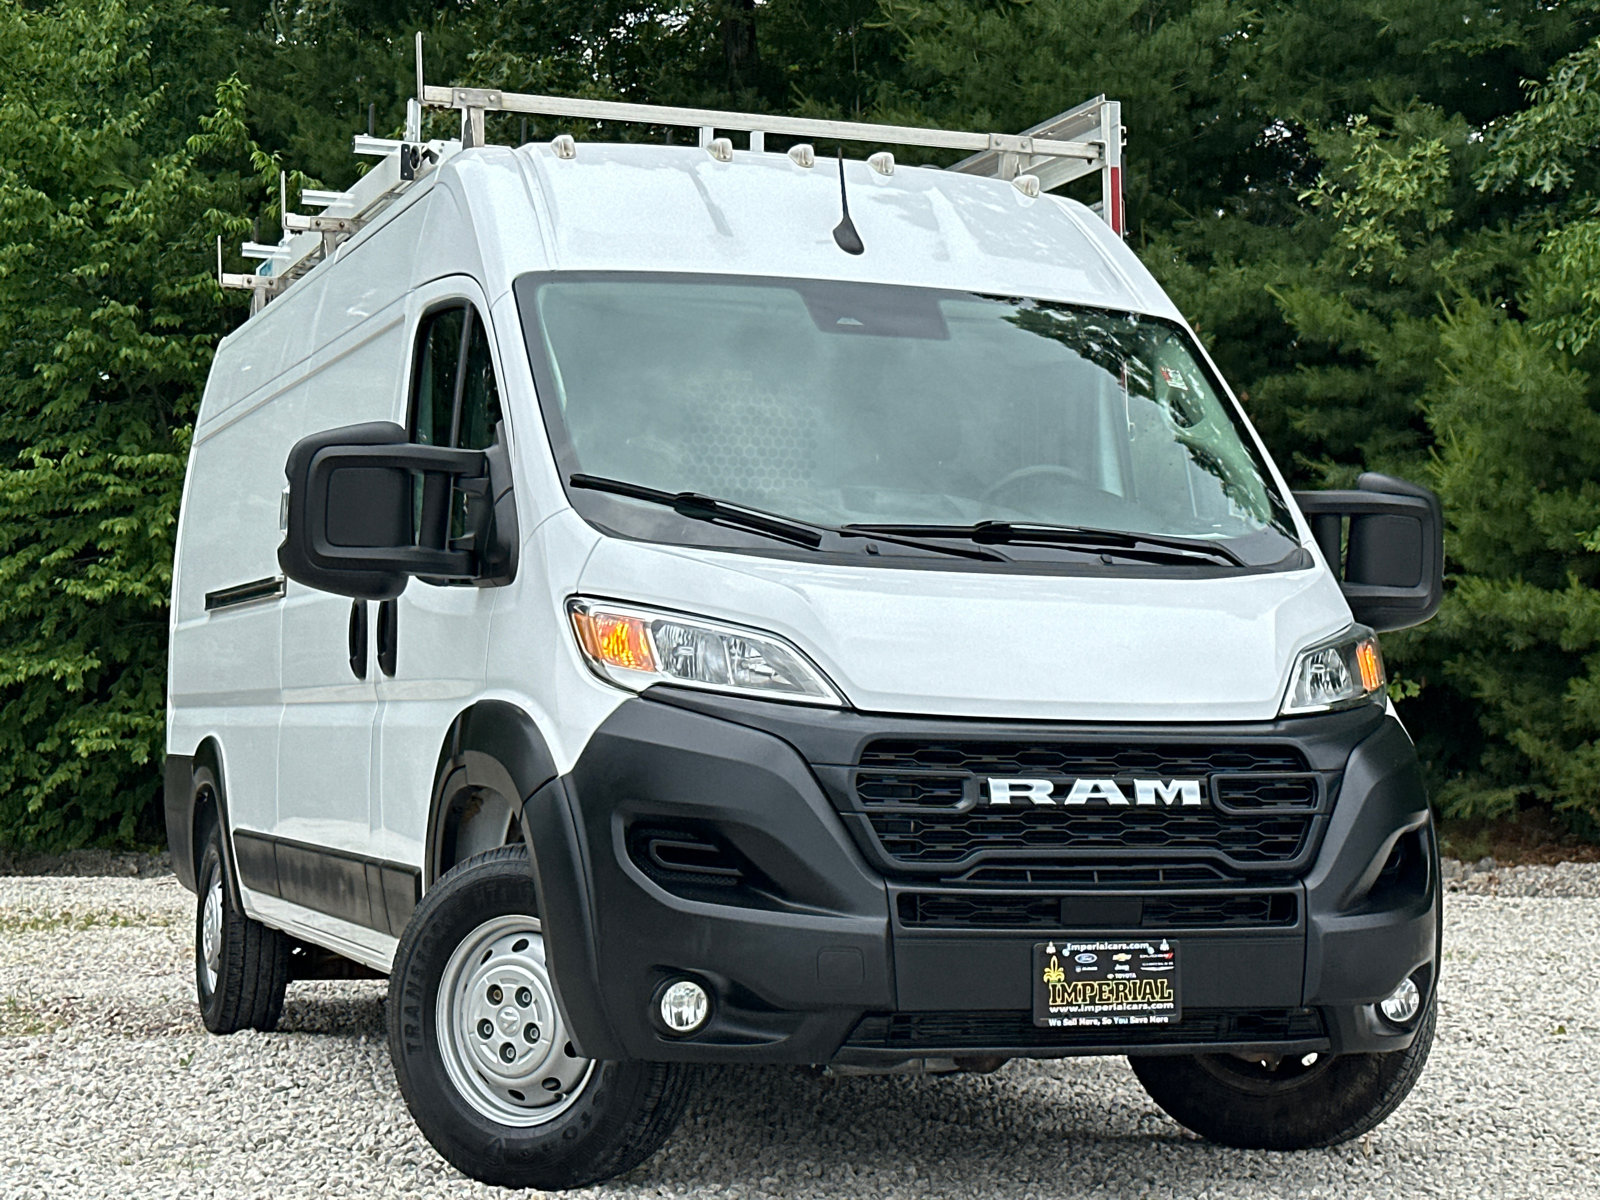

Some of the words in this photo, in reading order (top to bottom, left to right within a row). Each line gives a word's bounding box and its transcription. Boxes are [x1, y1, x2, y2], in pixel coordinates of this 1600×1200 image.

[987, 777, 1202, 806] RAM
[1049, 978, 1174, 1005] IMPERIAL
[1049, 1002, 1174, 1013] www.imperialcars.com
[1048, 1018, 1061, 1027] We
[1062, 1017, 1078, 1026] Sell
[1101, 1016, 1112, 1025] So
[1113, 1016, 1129, 1025] You
[1129, 1015, 1148, 1024] Save
[1149, 1015, 1169, 1023] More
